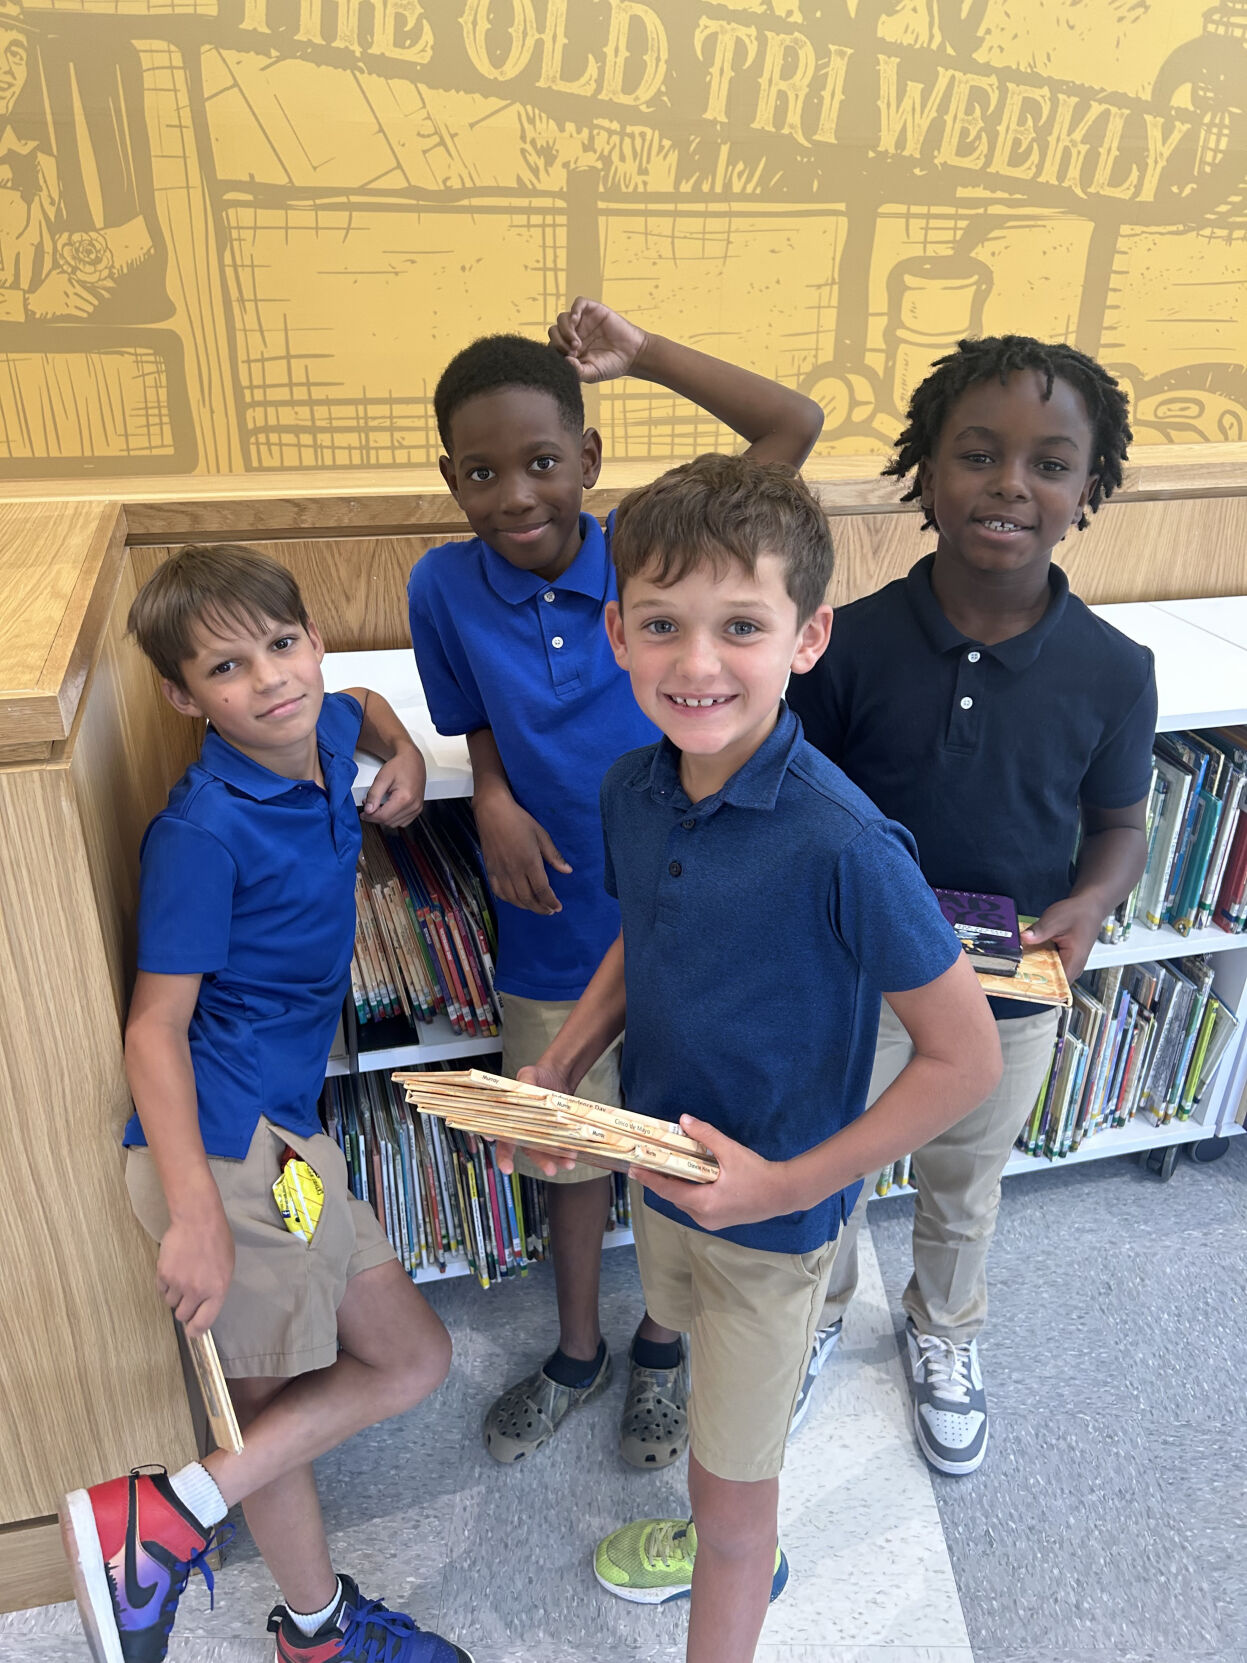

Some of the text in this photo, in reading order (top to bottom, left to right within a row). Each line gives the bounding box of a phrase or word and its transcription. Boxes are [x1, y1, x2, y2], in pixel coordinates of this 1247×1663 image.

[458, 0, 668, 106] OLD
[694, 15, 855, 148] TRI
[876, 54, 1192, 202] WEEKLY
[482, 1074, 499, 1084] Murray
[614, 1118, 629, 1129] Cinco
